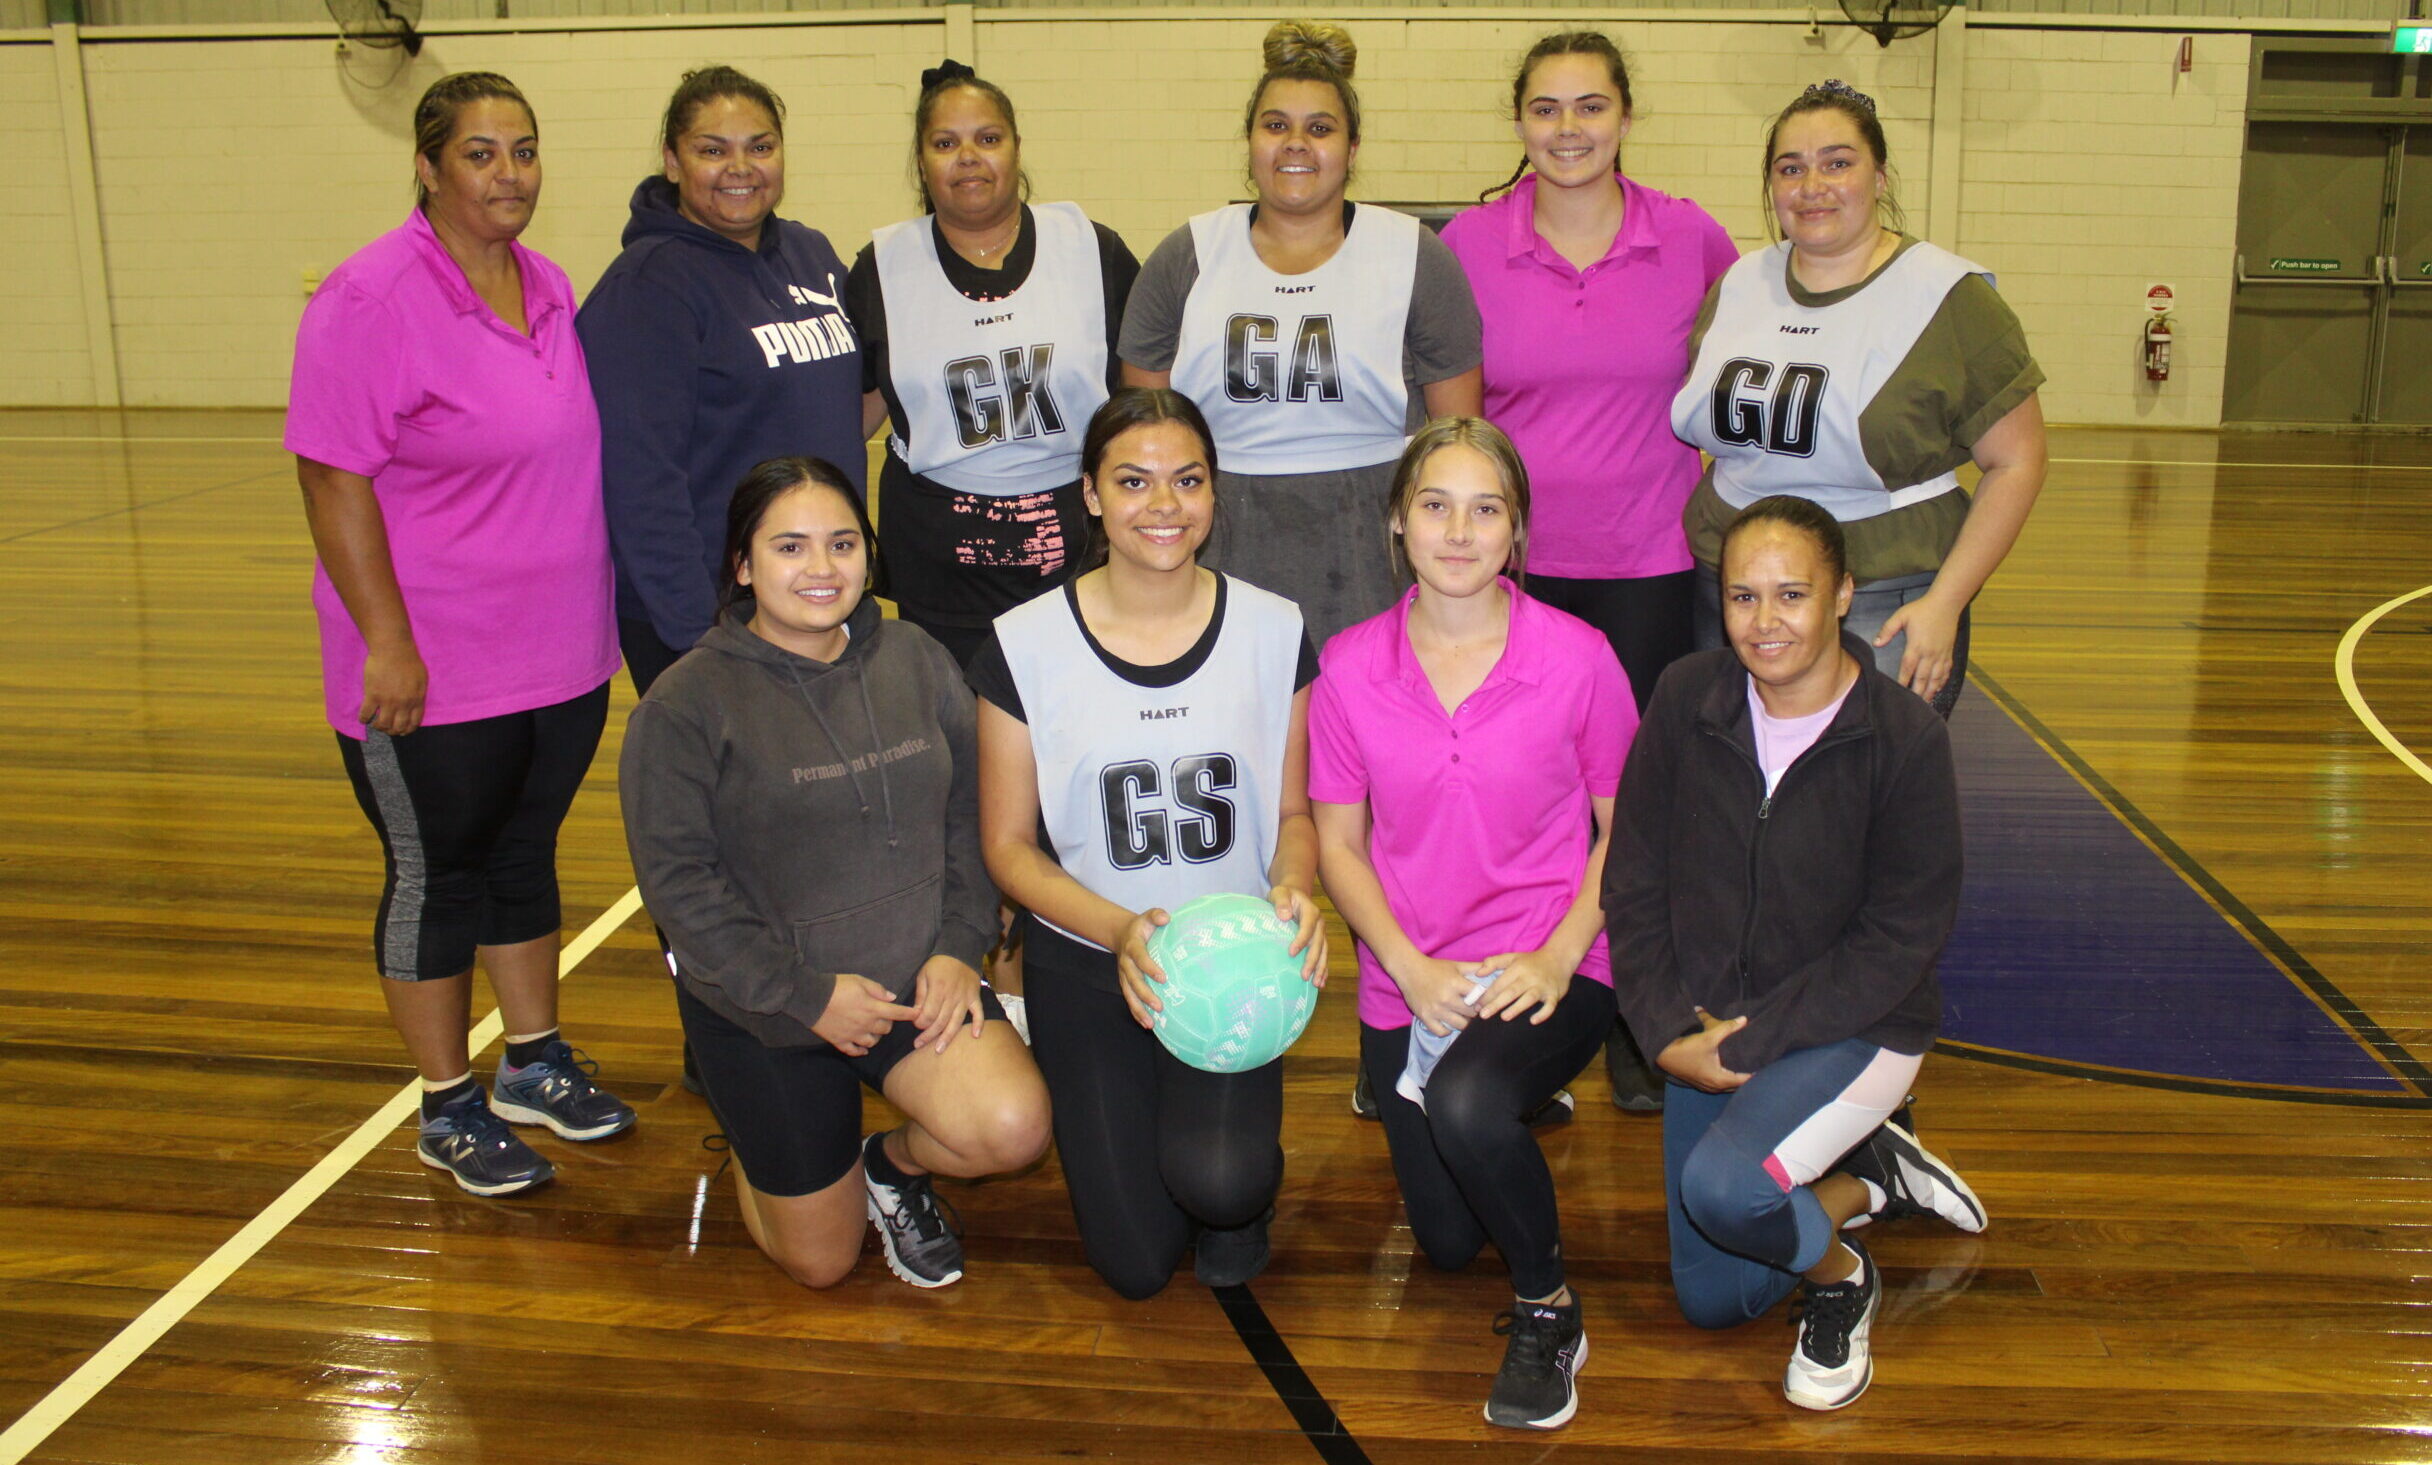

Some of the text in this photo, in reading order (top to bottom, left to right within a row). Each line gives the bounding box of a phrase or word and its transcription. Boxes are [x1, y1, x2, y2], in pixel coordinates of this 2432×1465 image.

[2281, 261, 2299, 269] Push
[2321, 263, 2338, 271] open
[1275, 285, 1316, 294] HART
[975, 312, 1014, 327] HART
[1779, 325, 1820, 335] HART
[751, 313, 857, 368] PUMA
[1224, 313, 1344, 403] GA
[943, 343, 1066, 450] GK
[1710, 356, 1830, 459] GD
[1140, 706, 1189, 721] HART
[791, 756, 867, 784] Permannt
[1099, 752, 1237, 871] GS
